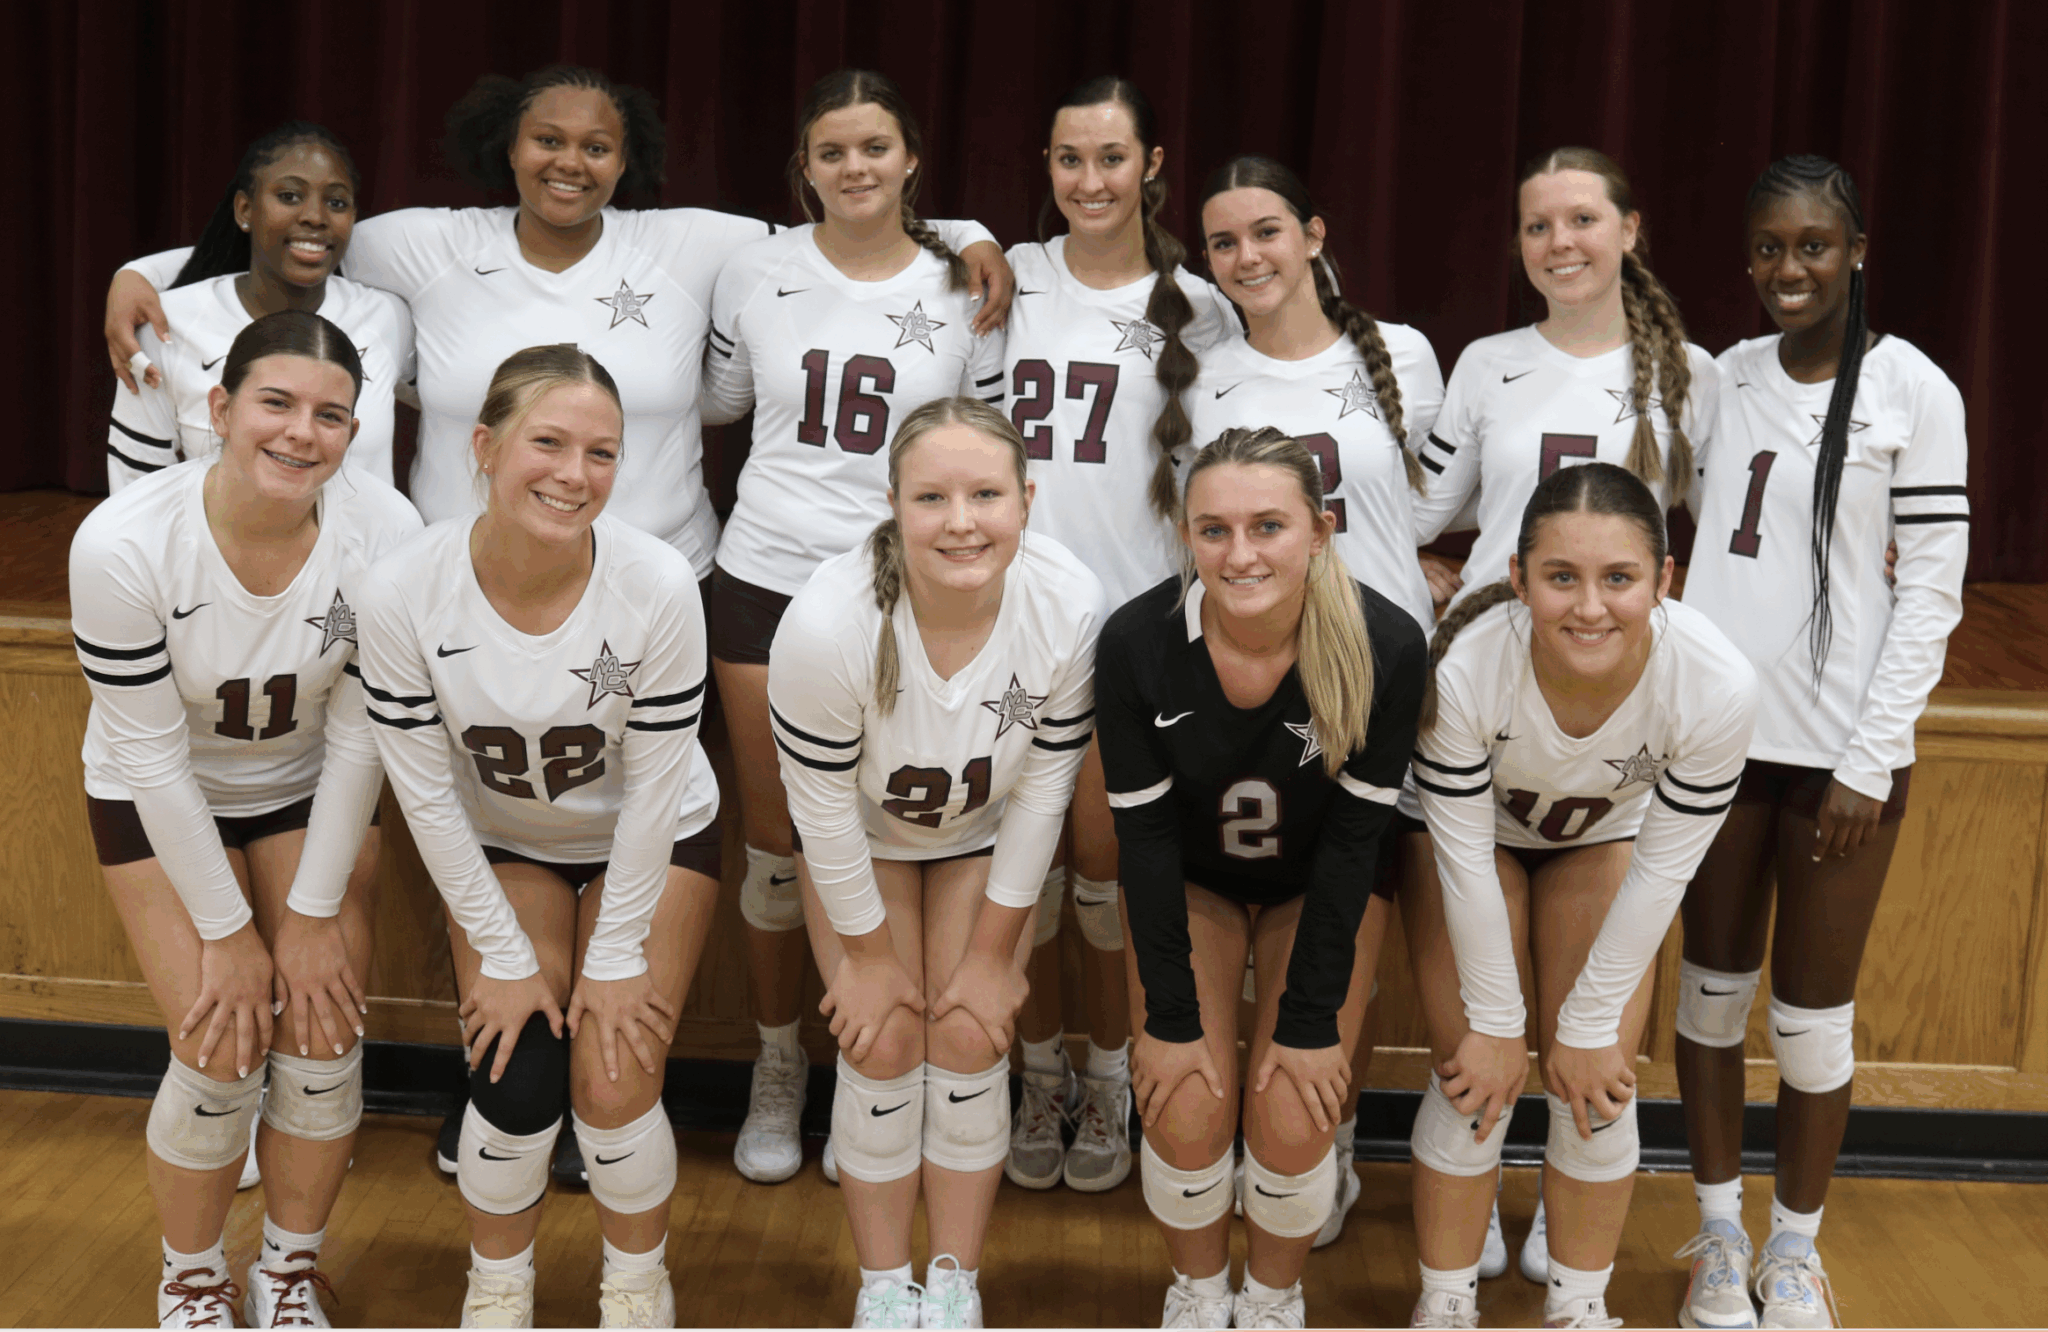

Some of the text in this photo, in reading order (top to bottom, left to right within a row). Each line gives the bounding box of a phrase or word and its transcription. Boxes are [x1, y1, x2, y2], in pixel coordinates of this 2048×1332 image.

[612, 290, 641, 315] MC
[901, 311, 931, 339] MC
[797, 348, 896, 456] 16
[1011, 359, 1120, 464] 27
[1728, 449, 1778, 559] 1
[215, 674, 298, 741] 11
[590, 655, 628, 690] MC
[999, 688, 1033, 720] MC
[461, 723, 606, 803] 22
[882, 755, 992, 829] 21
[1218, 776, 1282, 859] 2
[1501, 788, 1614, 842] 10
